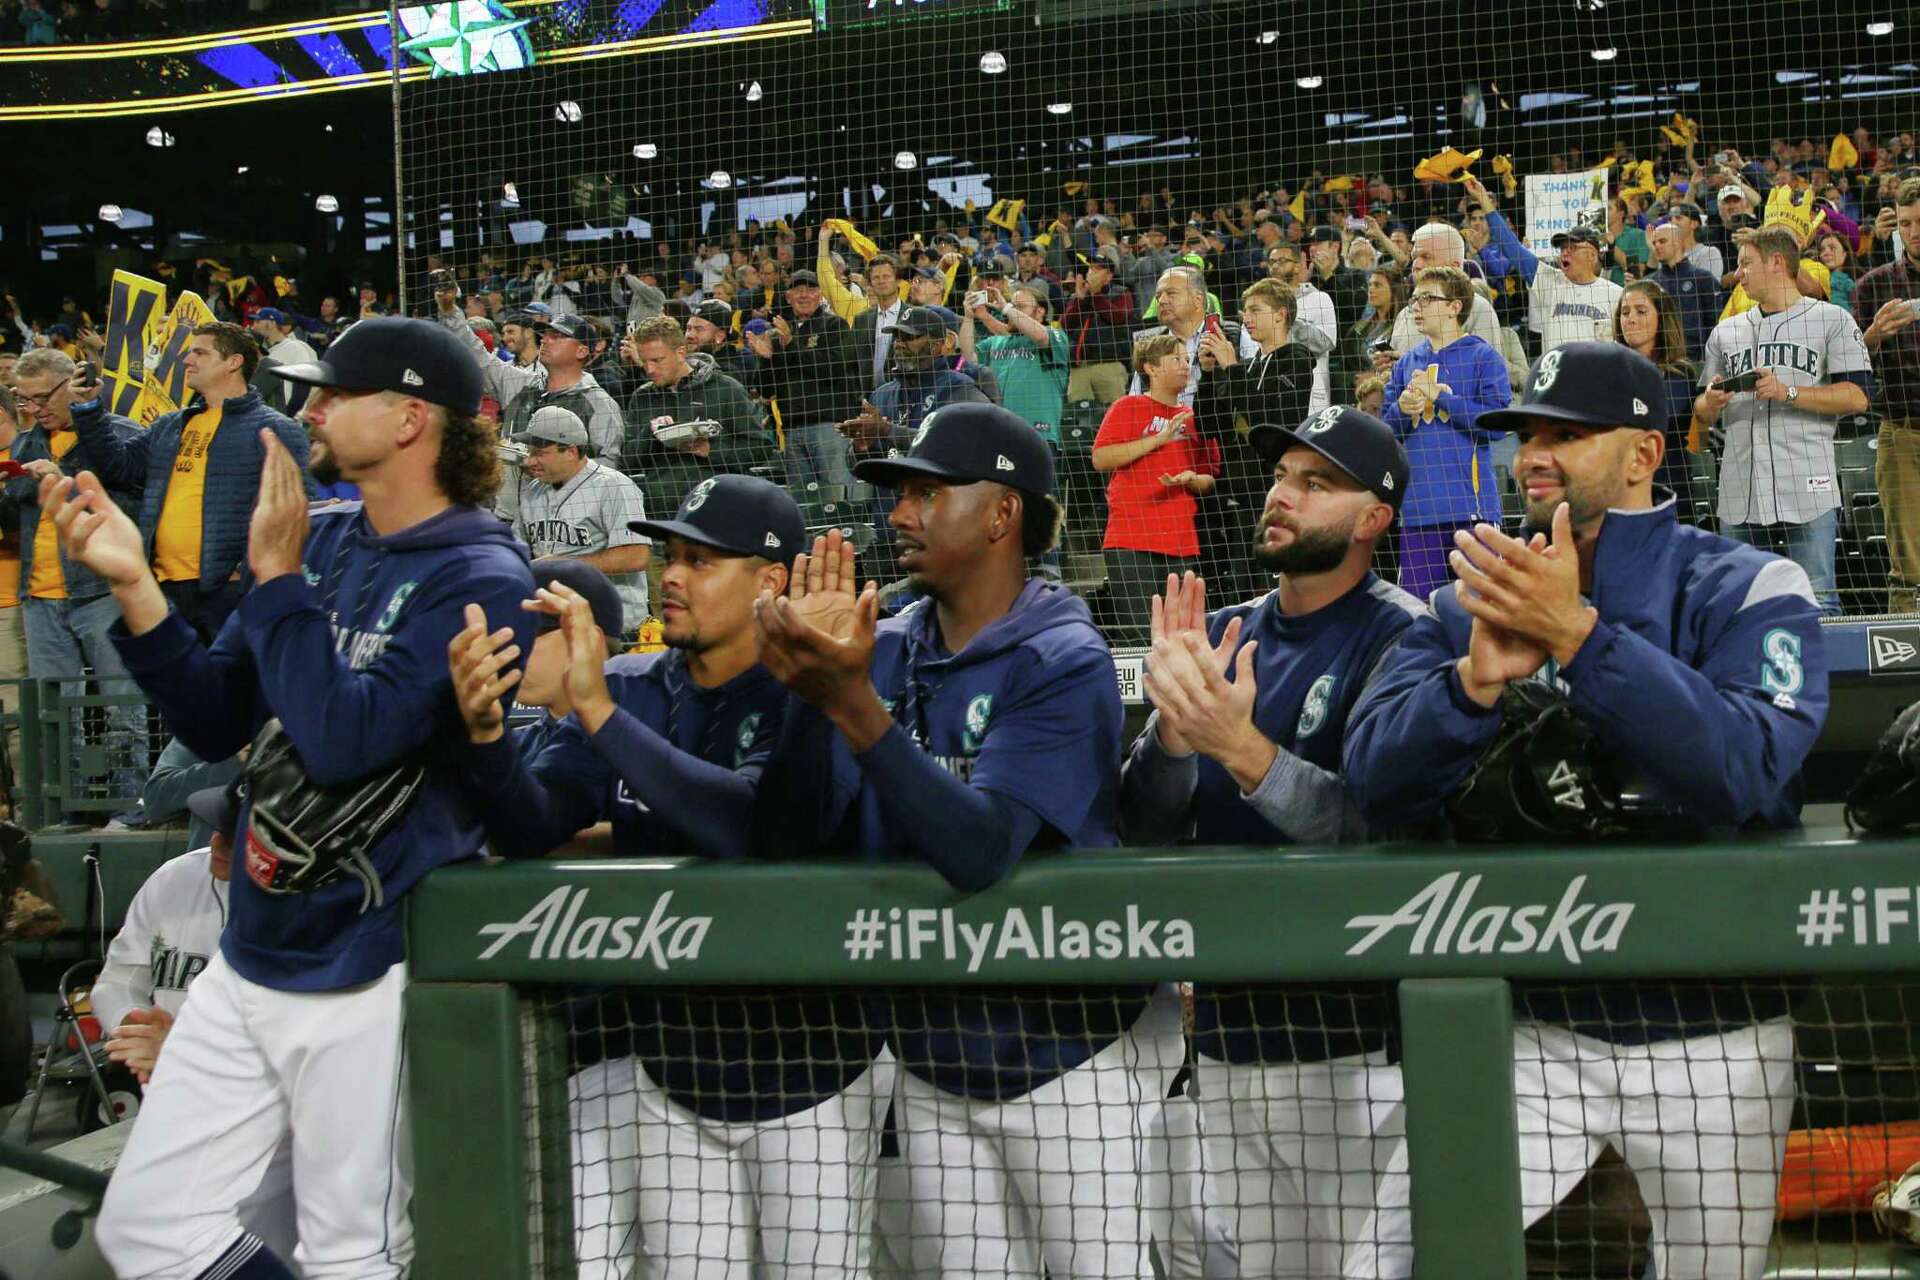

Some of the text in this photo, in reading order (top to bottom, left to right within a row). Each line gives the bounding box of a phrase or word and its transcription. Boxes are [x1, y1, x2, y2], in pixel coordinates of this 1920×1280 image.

[1562, 198, 1589, 209] YOU
[1535, 219, 1571, 230] KING
[524, 519, 592, 547] EATTLE
[1762, 628, 1803, 695] S
[1115, 668, 1135, 681] EW
[1117, 682, 1135, 696] RA
[477, 871, 1920, 974] Alaska #iFlyAlaska Alaska #iF
